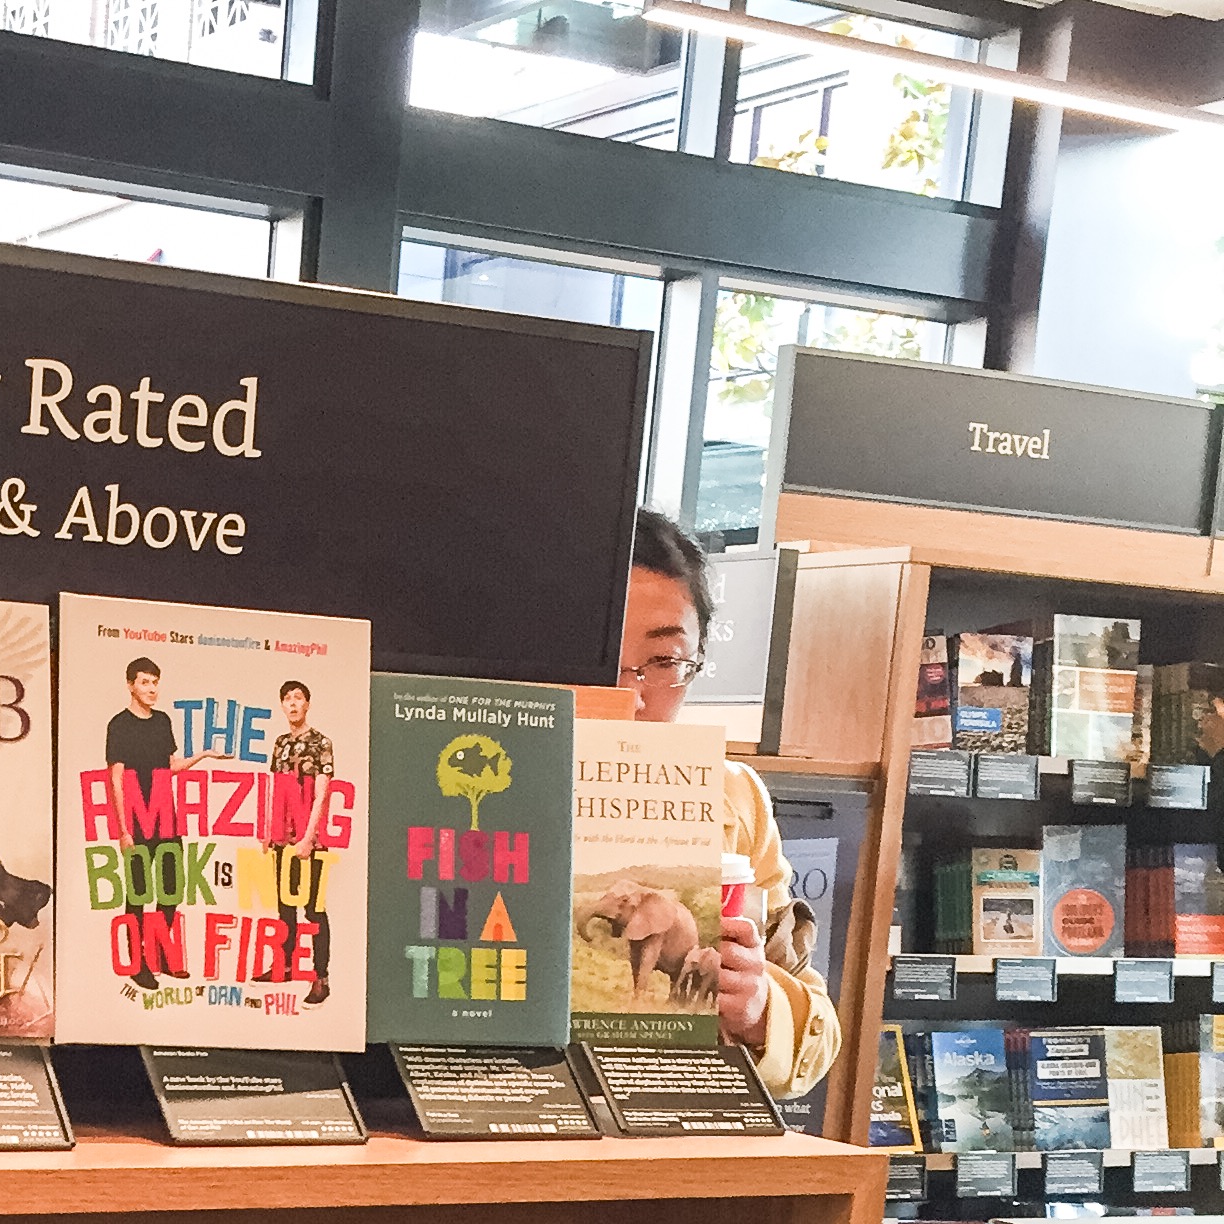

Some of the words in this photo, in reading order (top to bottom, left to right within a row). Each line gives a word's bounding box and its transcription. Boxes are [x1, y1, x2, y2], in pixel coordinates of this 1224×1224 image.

[21, 358, 261, 457] Rated
[968, 422, 1050, 460] Travel
[56, 483, 245, 554] Above
[98, 625, 119, 638] From
[123, 628, 167, 642] YouTube
[170, 631, 194, 645] Stars
[395, 704, 446, 721] Lynda
[453, 708, 512, 727] Mullaly
[517, 710, 555, 728] Hunt
[449, 695, 469, 704] ONE
[472, 696, 491, 705] FOR
[494, 698, 512, 707] THE
[173, 698, 272, 763] THE
[578, 761, 712, 786] LEPHANT
[80, 769, 355, 849] AMAZING
[576, 797, 714, 823] HISPERER
[85, 842, 217, 909] BOOK
[214, 861, 232, 887] IS
[237, 844, 340, 913] NOT
[407, 827, 529, 884] FISH
[420, 887, 468, 940] IN
[480, 891, 517, 942] A
[111, 911, 187, 976] ON
[204, 913, 320, 982] FIRE
[405, 946, 526, 1000] TREE
[120, 984, 138, 1001] THE
[143, 987, 192, 1009] WORLD
[208, 986, 242, 1007] DAN
[265, 993, 299, 1016] PHIL
[943, 1051, 995, 1067] Alaska
